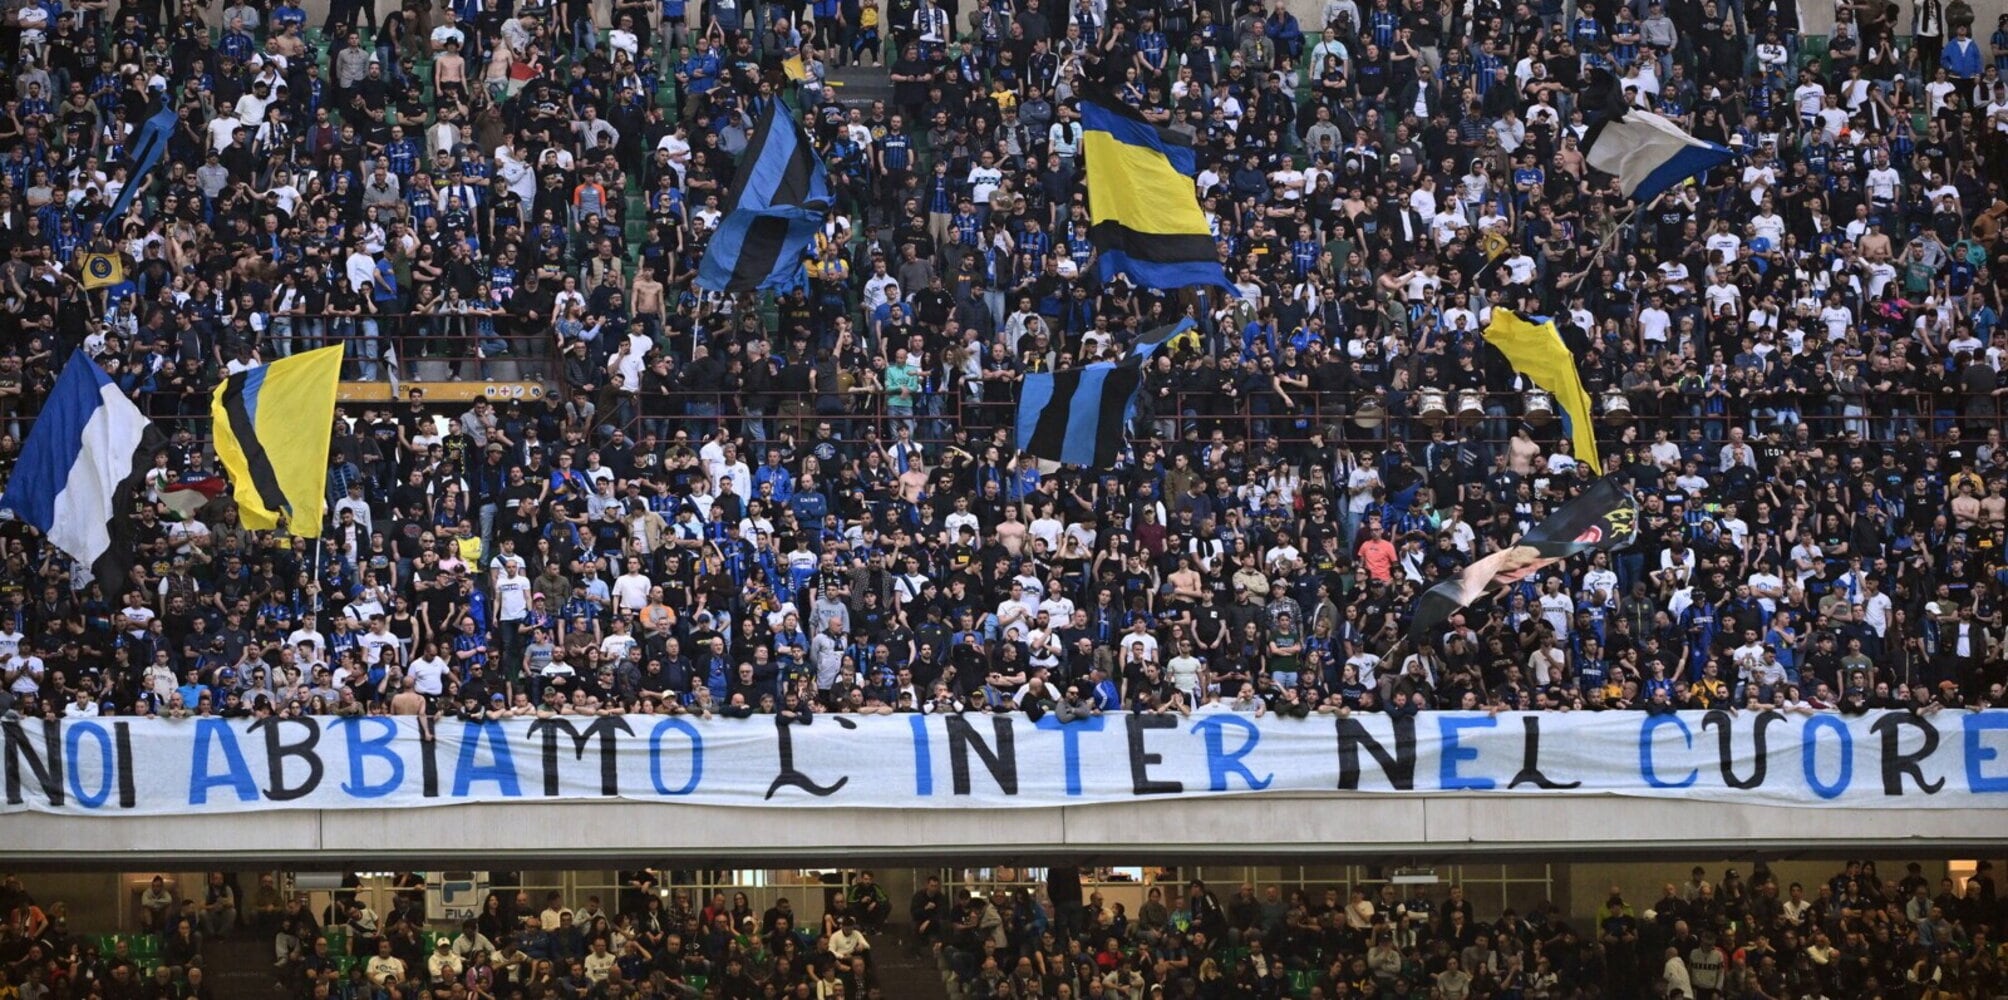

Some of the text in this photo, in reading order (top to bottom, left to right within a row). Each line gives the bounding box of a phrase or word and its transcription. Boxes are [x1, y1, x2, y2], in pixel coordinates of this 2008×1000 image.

[3, 716, 135, 808] NOI
[188, 715, 702, 801] ABBIAMO
[908, 713, 1274, 797] INTER
[1335, 715, 1581, 791] NEL
[1638, 710, 2008, 799] CUORE
[445, 908, 474, 919] FILA
